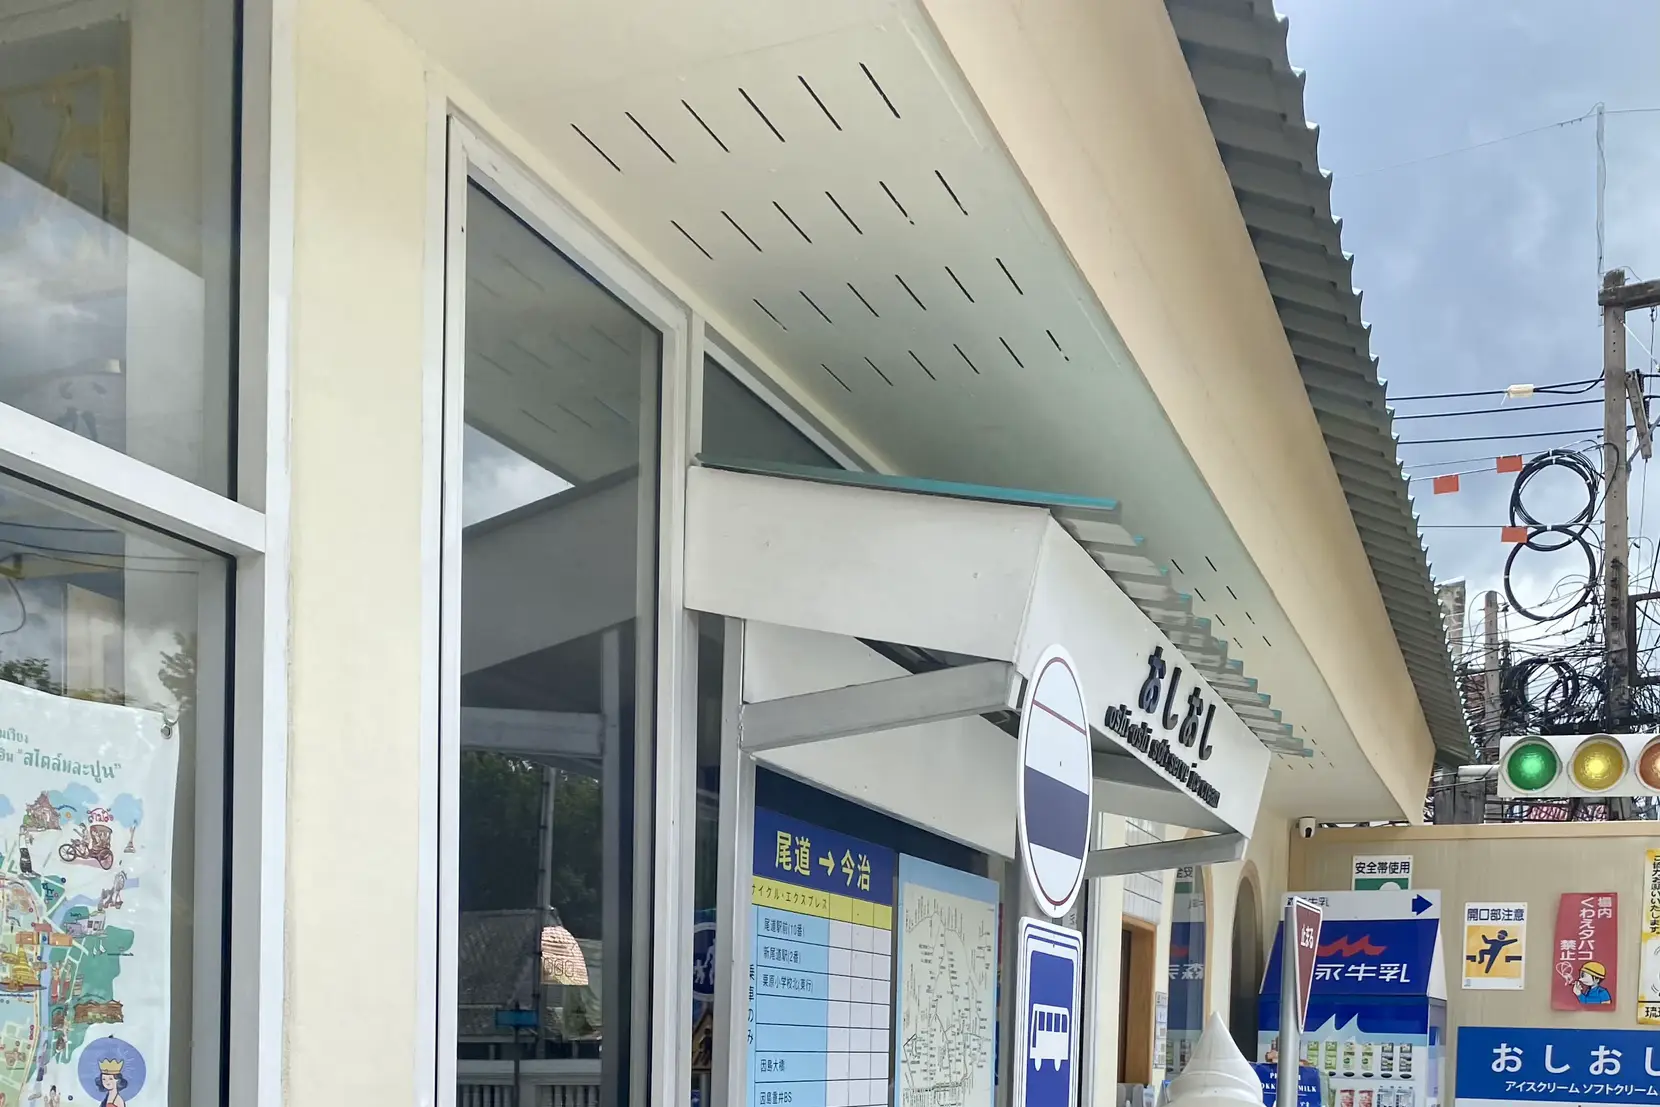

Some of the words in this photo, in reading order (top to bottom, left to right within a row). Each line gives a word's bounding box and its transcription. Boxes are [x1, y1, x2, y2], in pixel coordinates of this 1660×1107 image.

[1139, 646, 1216, 760] おしおし
[775, 830, 811, 876] 尾道
[841, 849, 871, 892] 今治
[1355, 861, 1411, 875] 安全帯使用
[1466, 908, 1525, 922] 開口部注意
[1577, 896, 1596, 961] くわえタバコ
[1560, 939, 1577, 961] 禁止
[1505, 1080, 1580, 1094] アイスクリーム
[1583, 1083, 1659, 1097] ソフトクリーム
